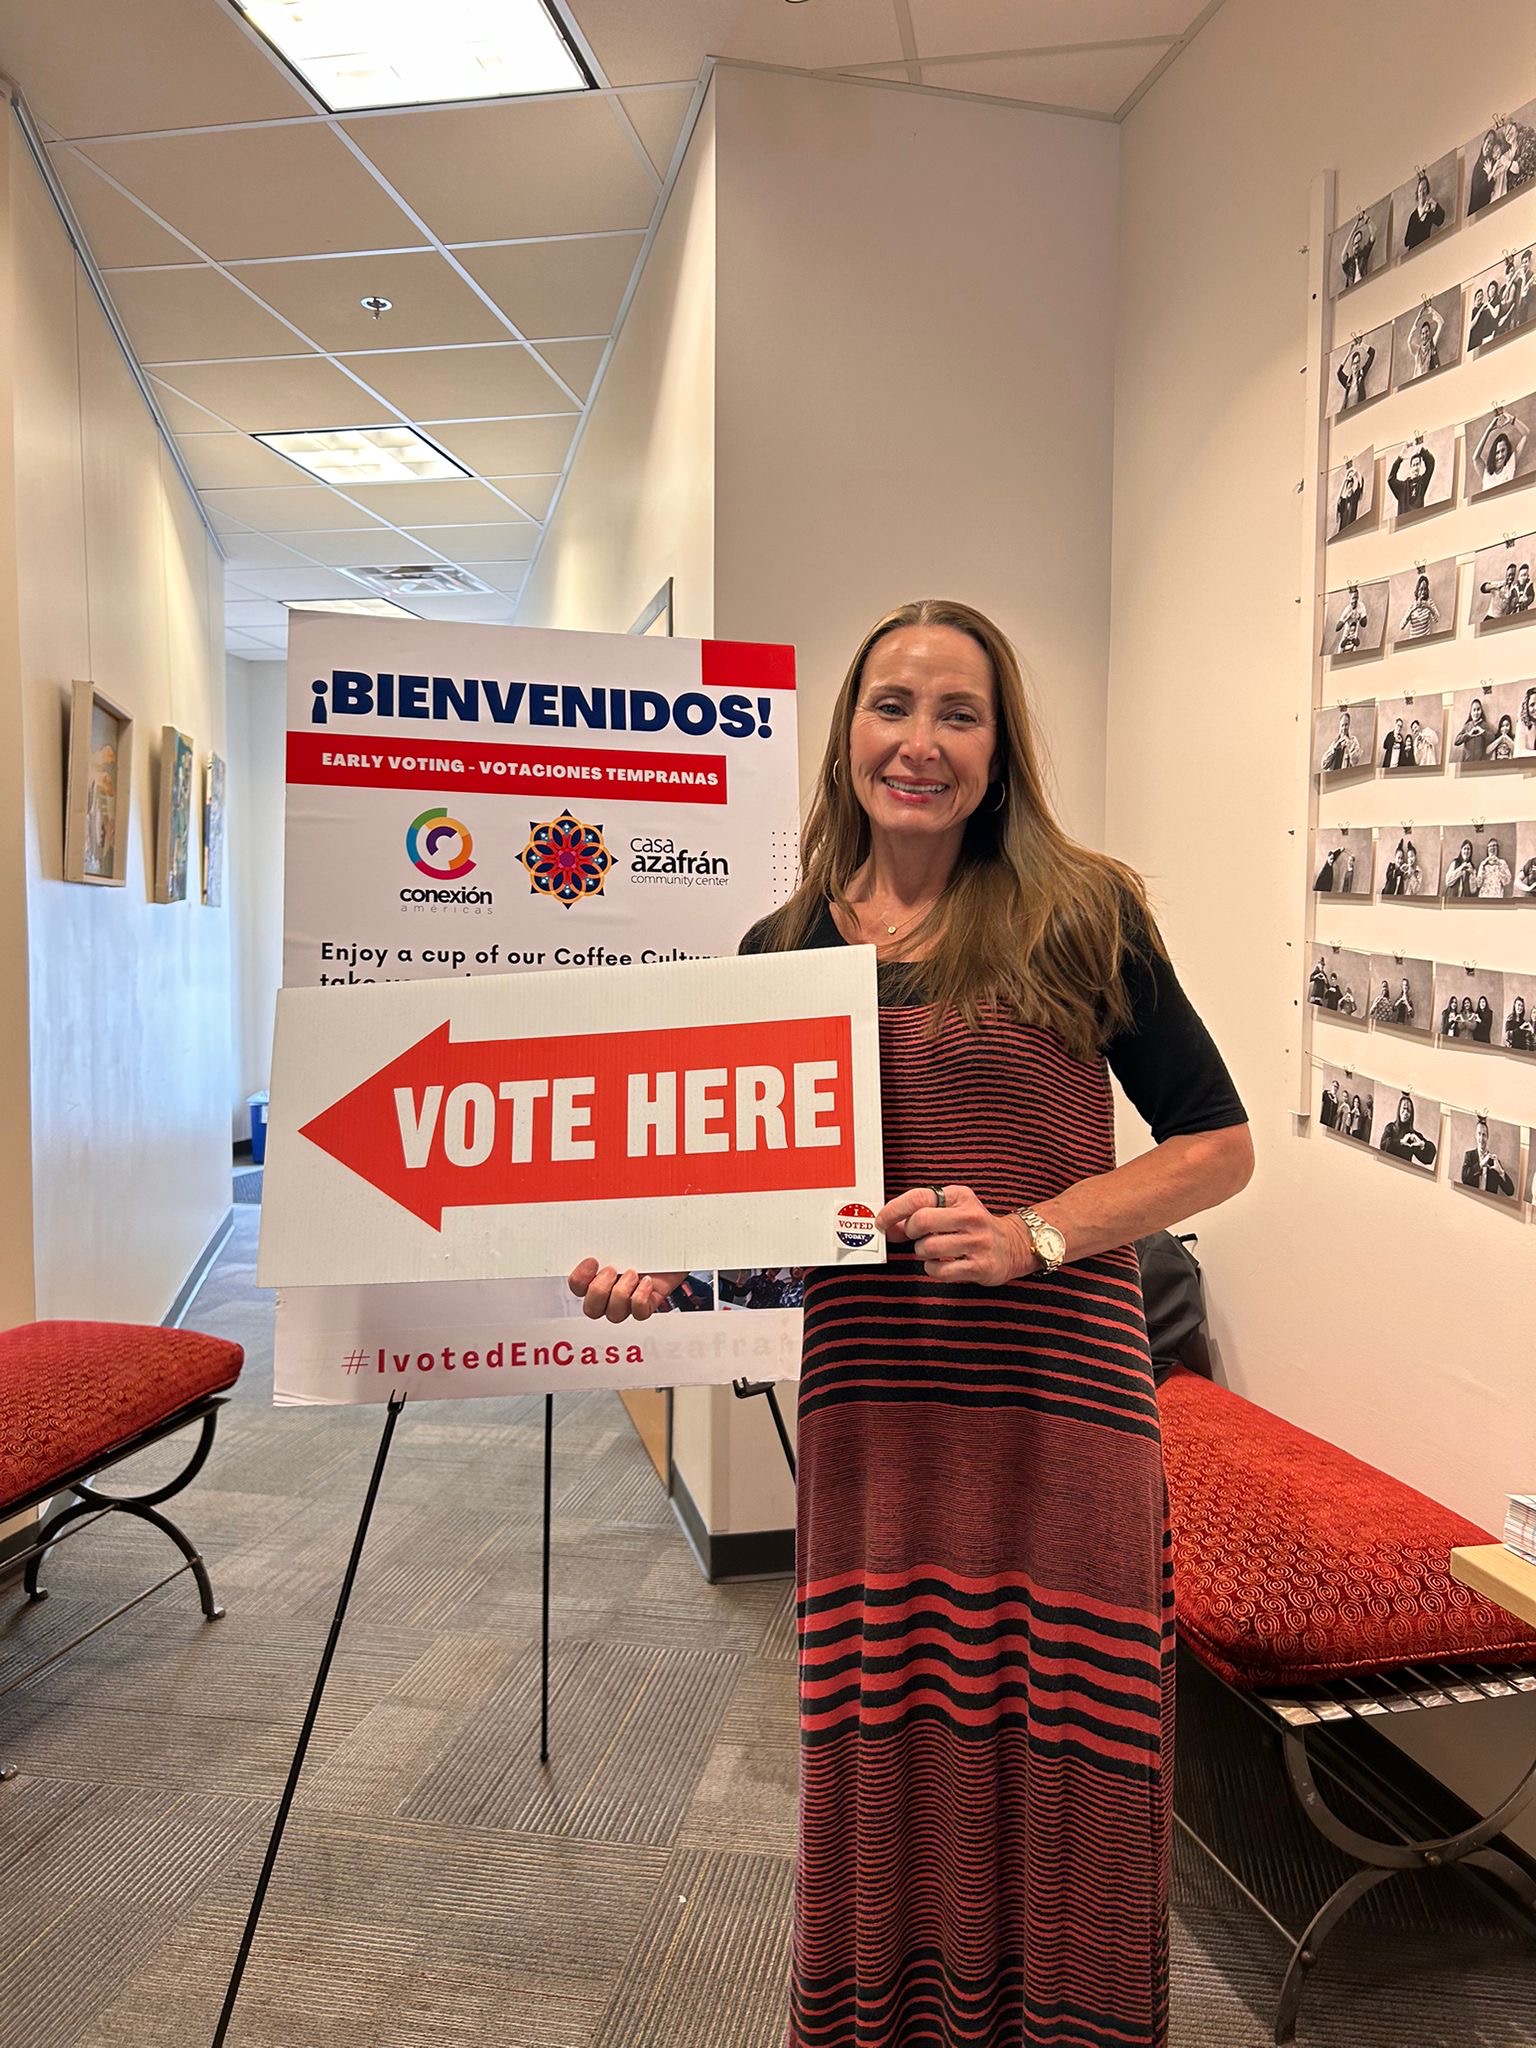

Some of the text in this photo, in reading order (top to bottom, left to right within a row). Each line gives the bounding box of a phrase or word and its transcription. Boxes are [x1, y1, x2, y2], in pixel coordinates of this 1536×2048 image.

[311, 670, 773, 738] ¡BIENVENIDOS!
[322, 752, 384, 768] EARLY
[388, 756, 465, 773] VOTING
[479, 760, 602, 780] VOTACIONES
[606, 768, 719, 786] TEMPRANAS
[630, 837, 674, 854] casa
[631, 849, 729, 875] azafrán
[631, 874, 729, 887] community center
[400, 886, 493, 904] conexión
[321, 942, 388, 967] Enjoy
[397, 949, 412, 962] a
[422, 950, 466, 969] cup
[475, 944, 499, 964] of
[507, 952, 546, 964] our
[554, 947, 632, 966] Coffee
[394, 1060, 842, 1169] VOTE HERE
[839, 1220, 873, 1230] VOTED
[854, 1208, 859, 1217] I
[341, 1340, 645, 1375] #IvotedEnCasa
